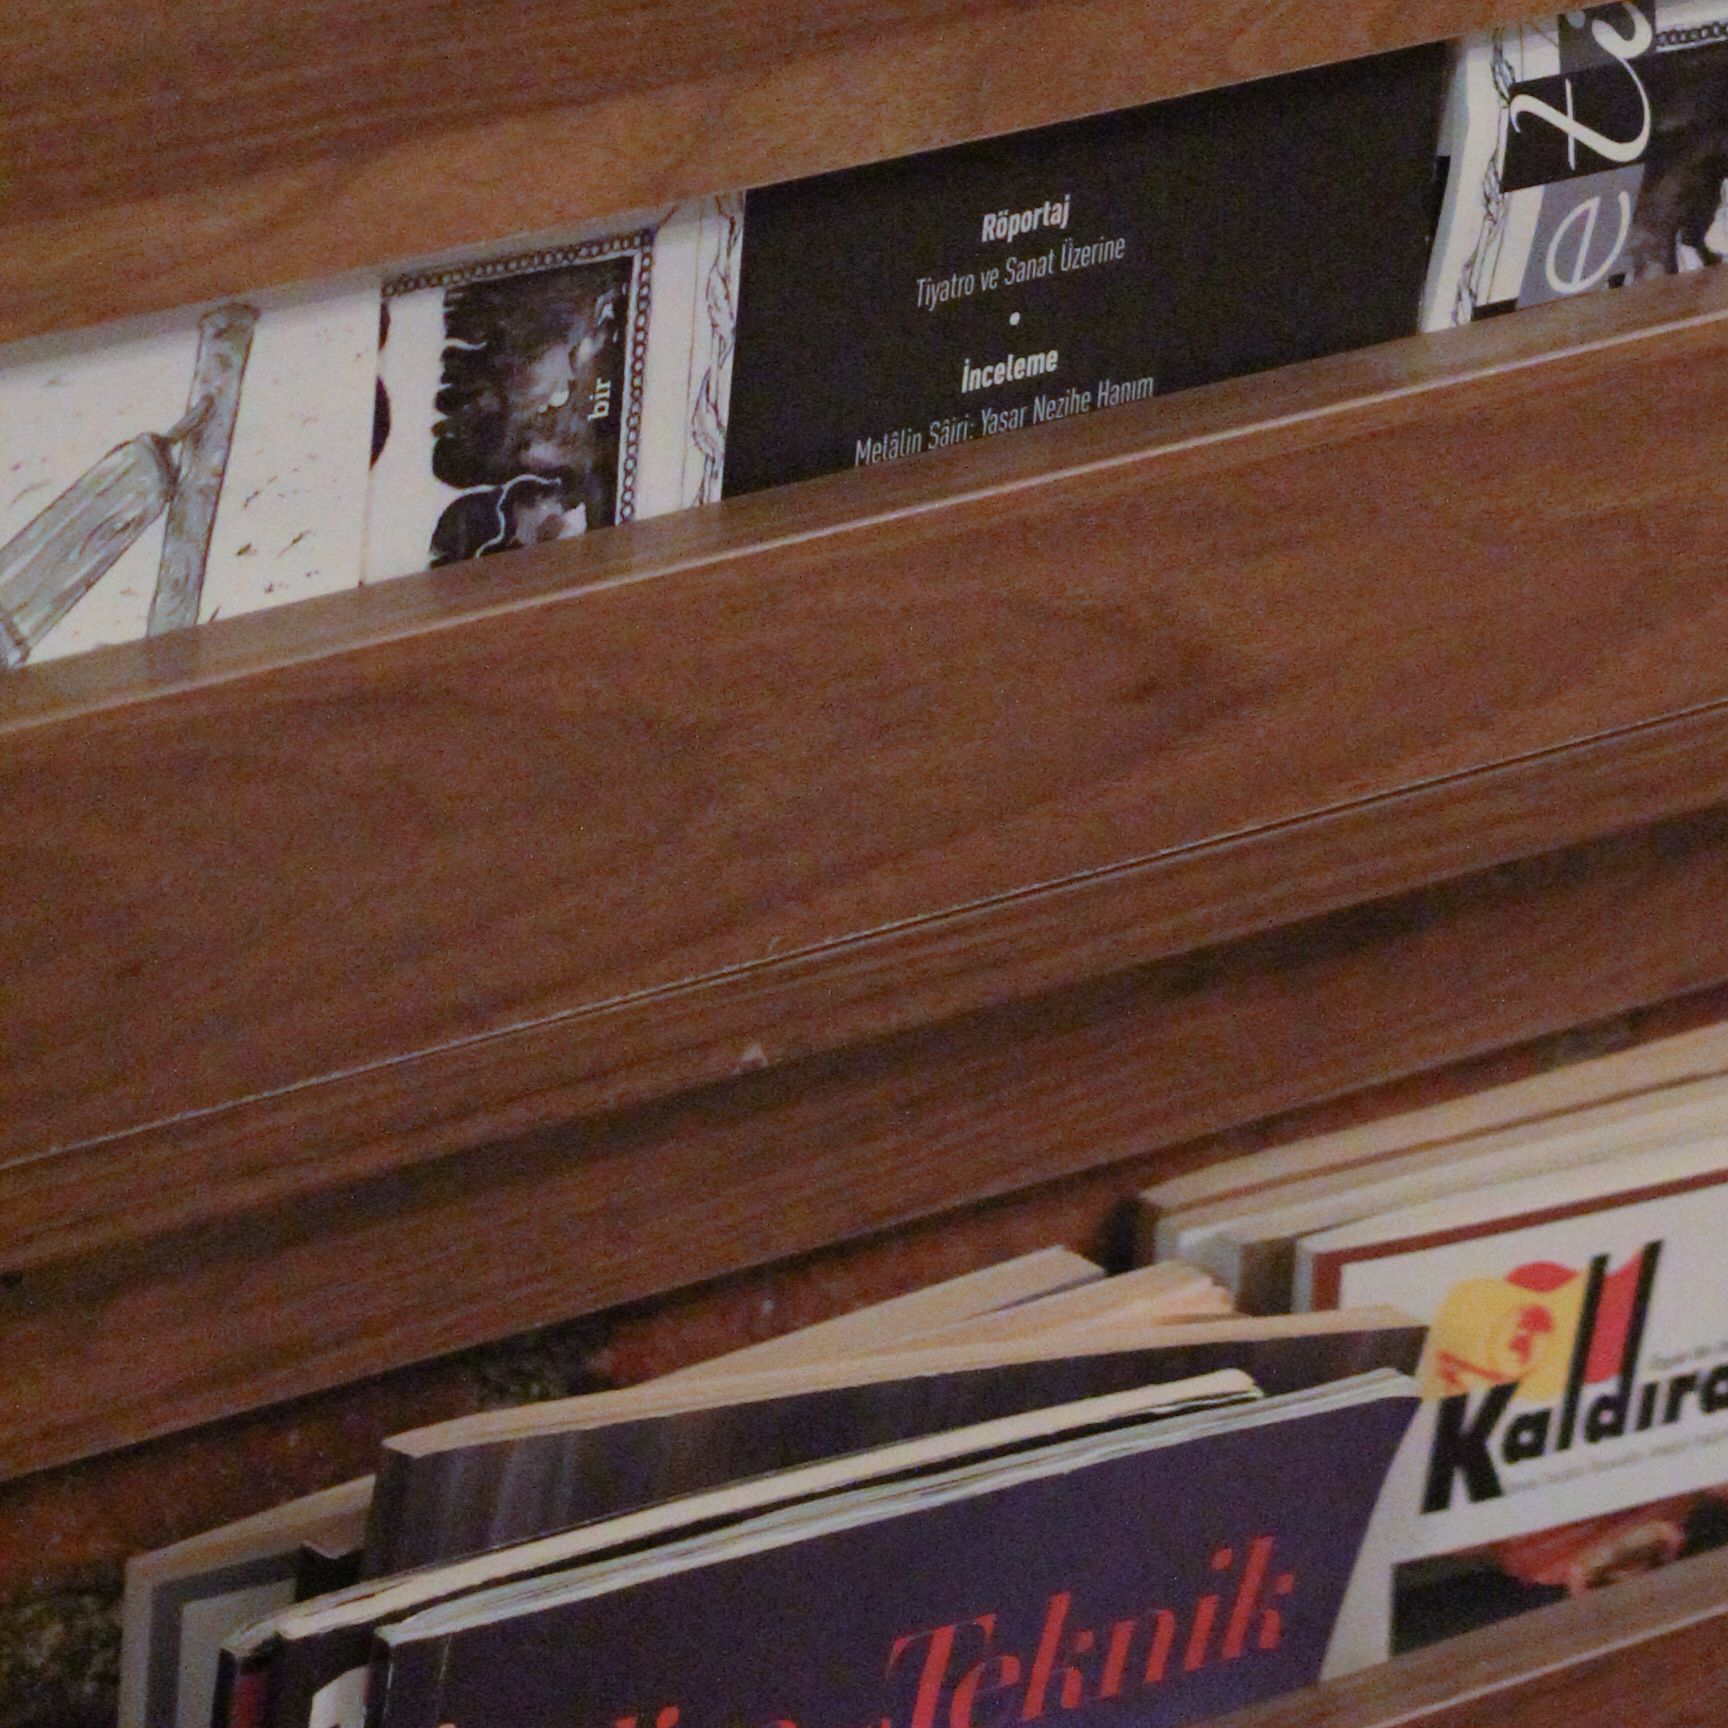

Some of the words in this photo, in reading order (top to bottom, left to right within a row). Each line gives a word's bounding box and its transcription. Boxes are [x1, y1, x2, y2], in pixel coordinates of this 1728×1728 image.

[981, 194, 1071, 244] Röportaj
[914, 270, 975, 310] Tiyatro
[979, 269, 1000, 290] ve
[1003, 251, 1055, 287] Sanat
[1059, 232, 1127, 274] Üzerine
[961, 345, 1060, 395] İnceleme
[586, 376, 613, 422] bir
[1032, 386, 1092, 424] Nezihe
[1095, 372, 1155, 410] Hanım
[882, 1533, 1297, 1728] Teknik
